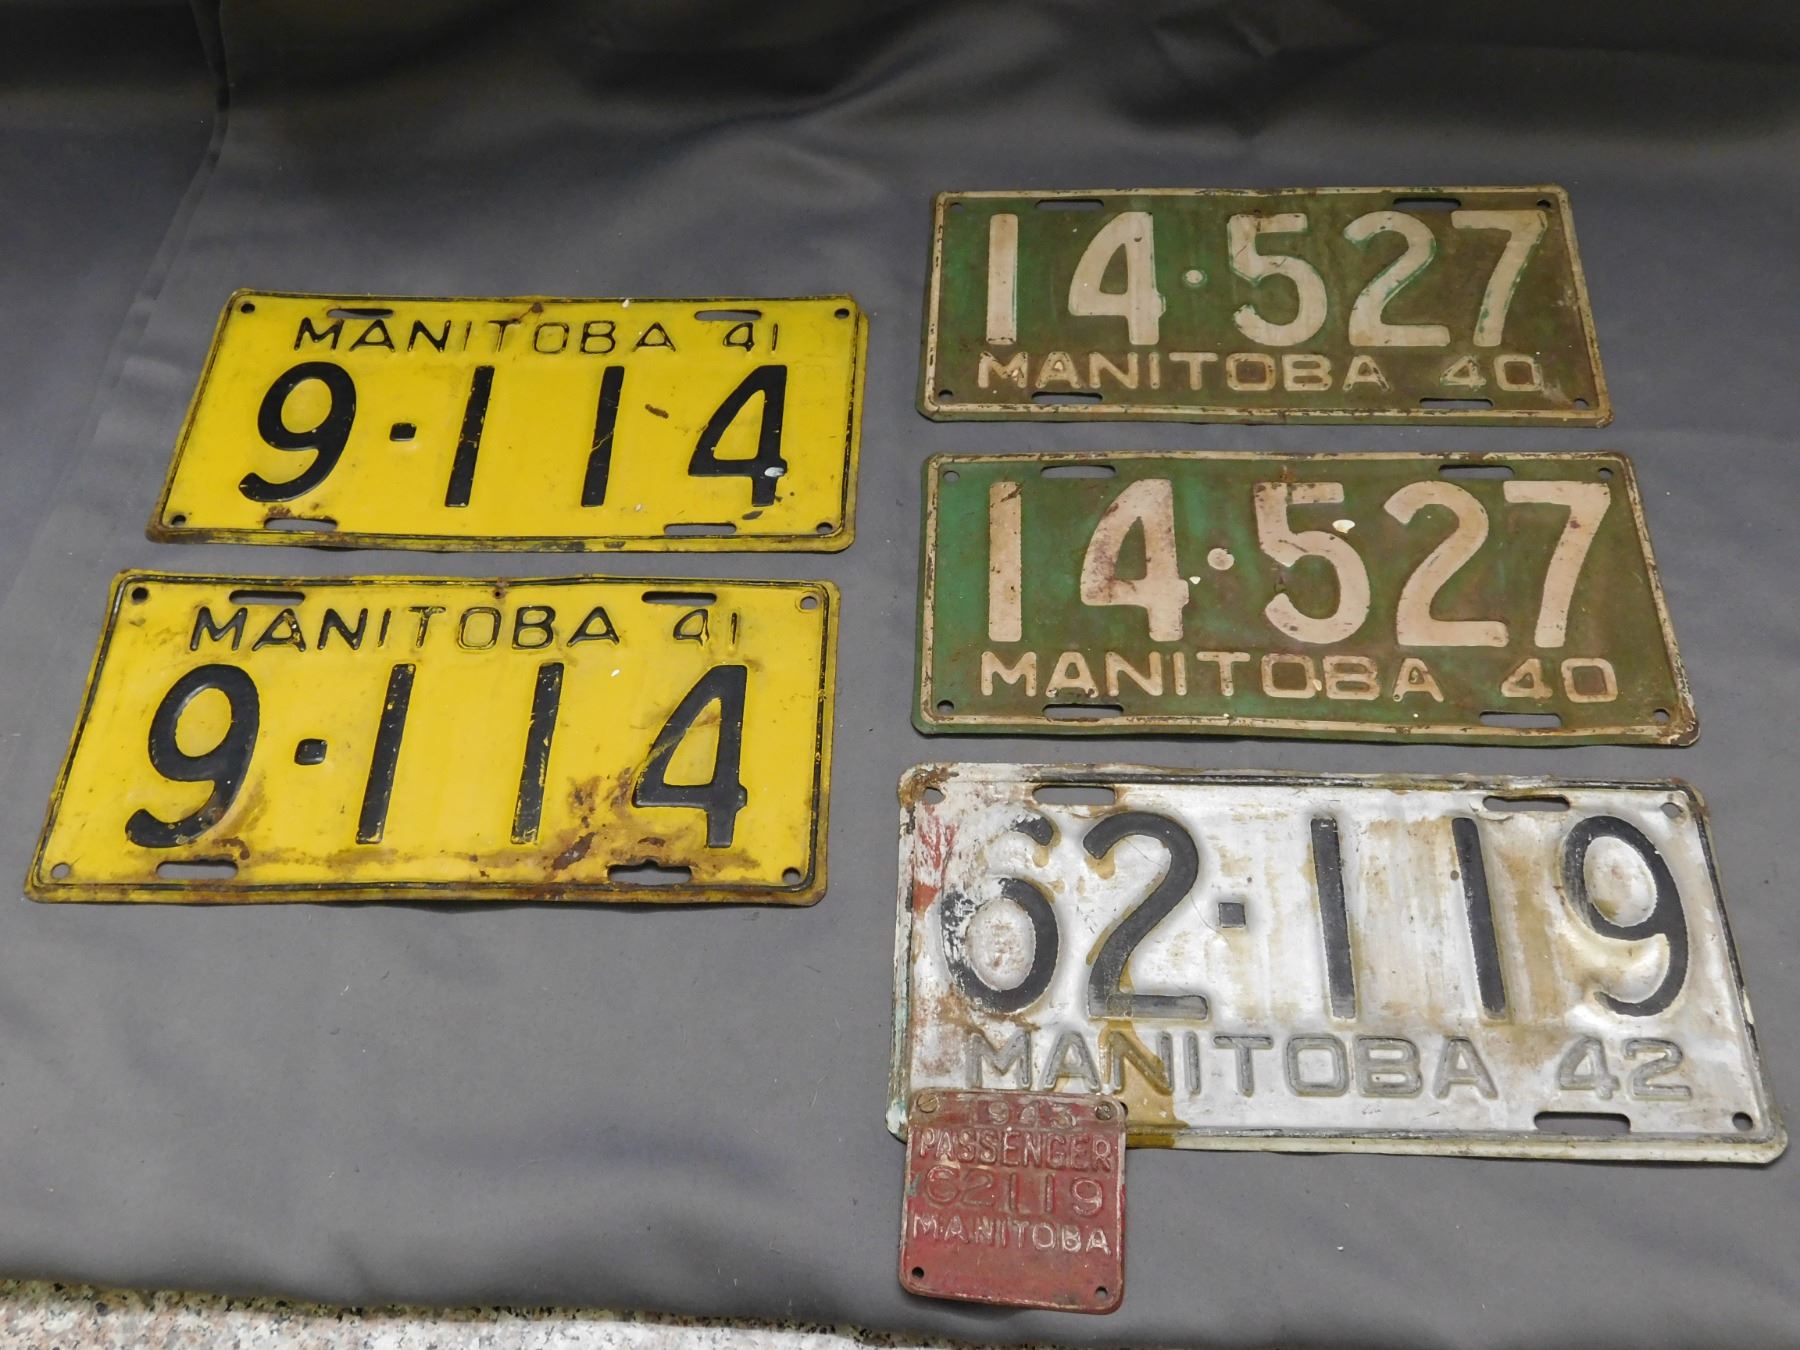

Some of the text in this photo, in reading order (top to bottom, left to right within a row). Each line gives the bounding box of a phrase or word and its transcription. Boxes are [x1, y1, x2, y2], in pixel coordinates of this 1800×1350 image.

[293, 316, 779, 354] MANITOBA 41
[977, 350, 1544, 394] MANITOBA 40
[189, 605, 738, 653] MANITOBA 41
[980, 650, 1618, 704] MANITOBA 40
[964, 1030, 1693, 1104] MANITOBA 42
[970, 1100, 1078, 1128] 1943
[918, 1127, 1112, 1172] PASSENGER
[912, 1213, 1112, 1255] MANITOBA
